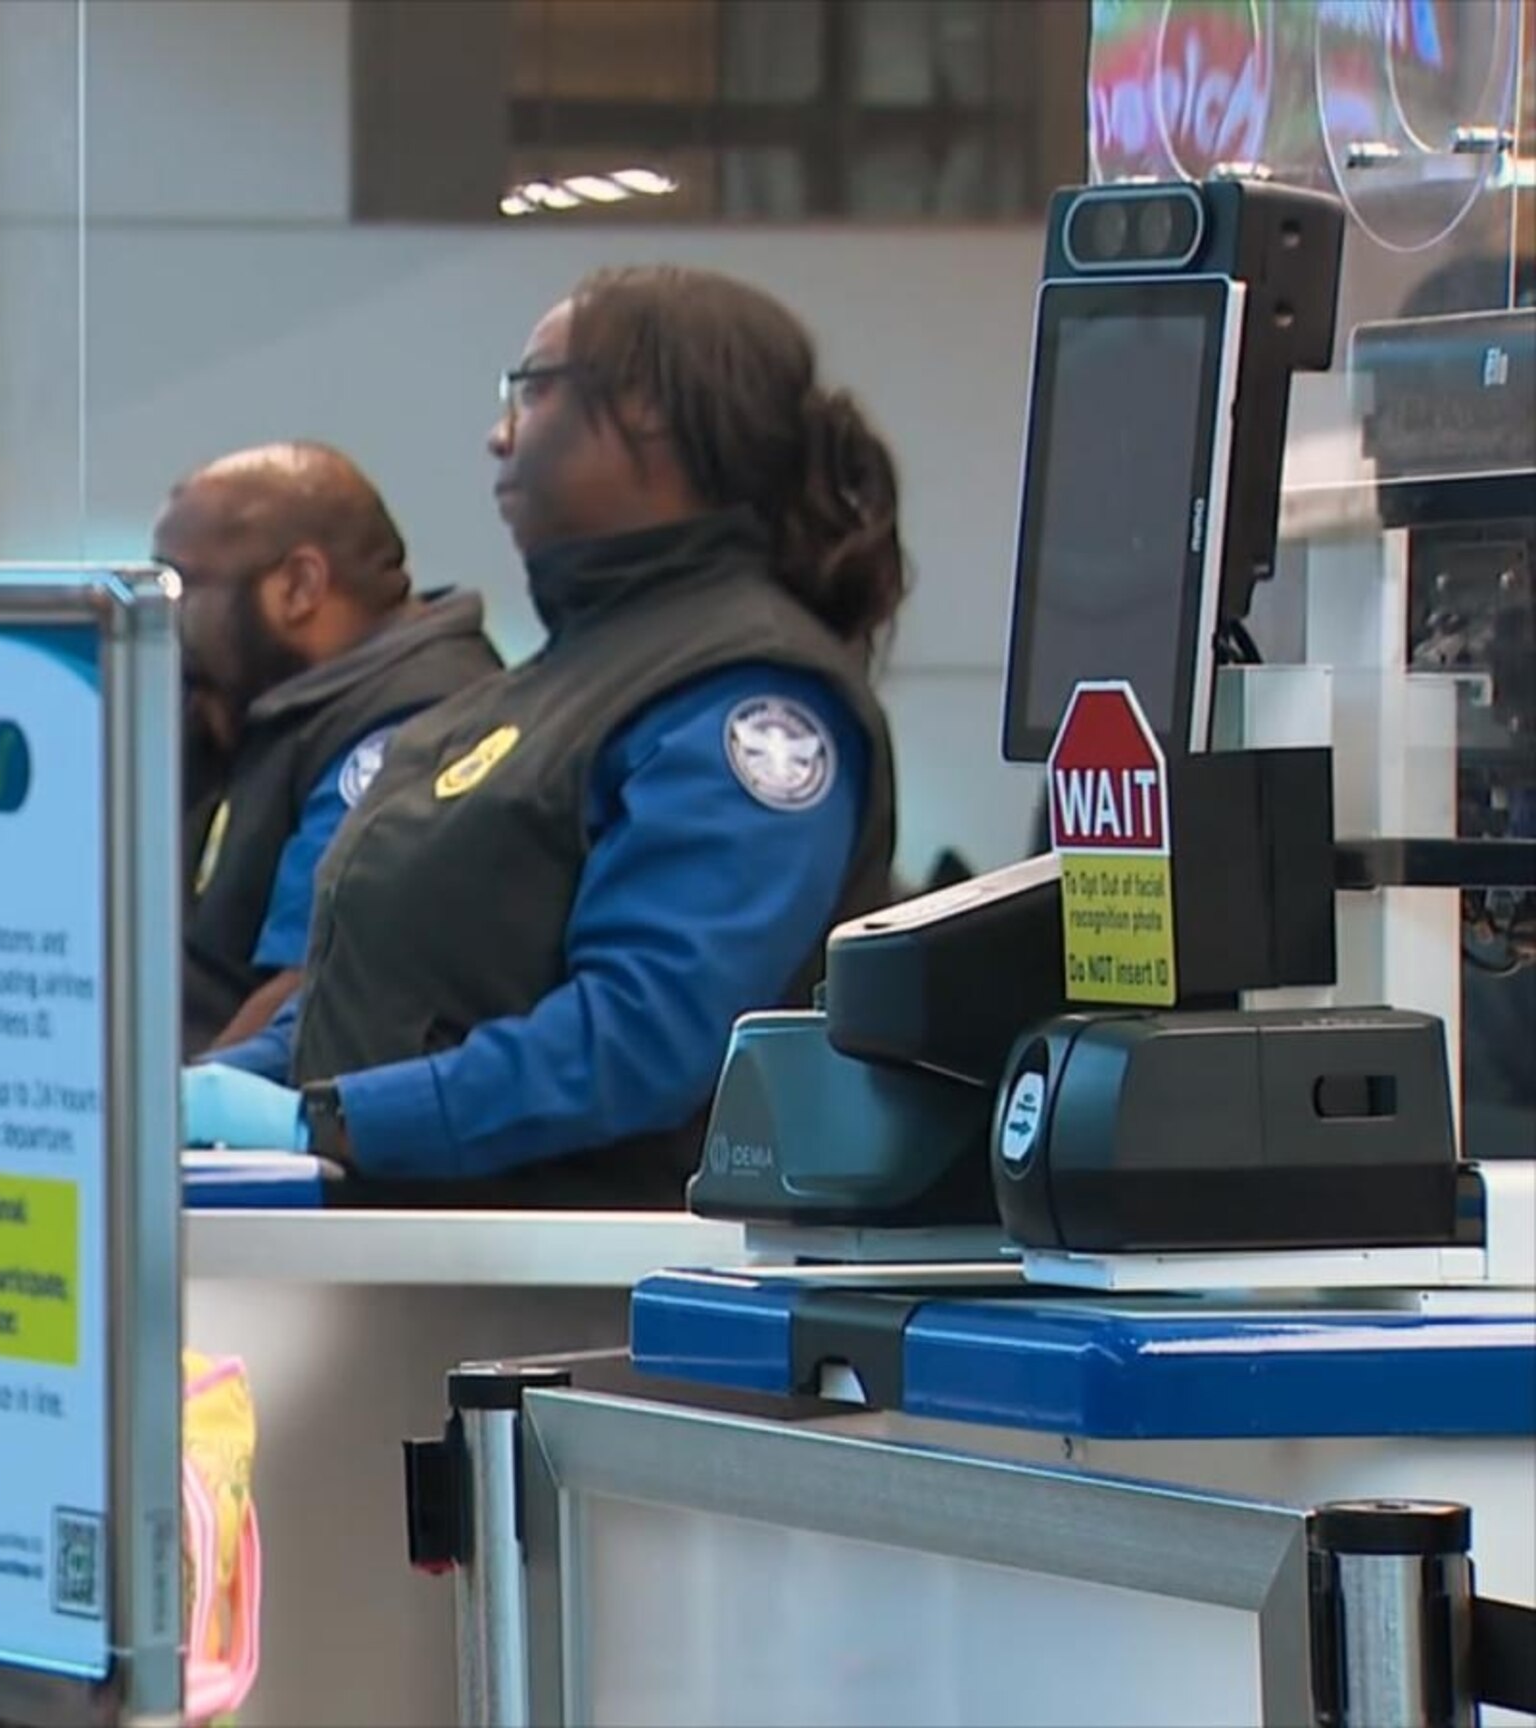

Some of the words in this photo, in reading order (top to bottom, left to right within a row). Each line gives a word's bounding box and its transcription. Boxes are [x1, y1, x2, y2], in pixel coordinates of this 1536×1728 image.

[1055, 768, 1157, 838] WAIT
[1064, 870, 1077, 896] To
[1080, 871, 1097, 900] Opt
[1101, 871, 1119, 897] Out
[1122, 872, 1133, 897] of
[1135, 872, 1165, 898] facial
[1070, 908, 1130, 935] recognition
[1133, 909, 1162, 937] photo
[41, 931, 68, 956] and
[1069, 953, 1085, 984] Do
[1088, 954, 1113, 985] NOT
[1116, 956, 1153, 986] insert
[1154, 958, 1169, 987] ID
